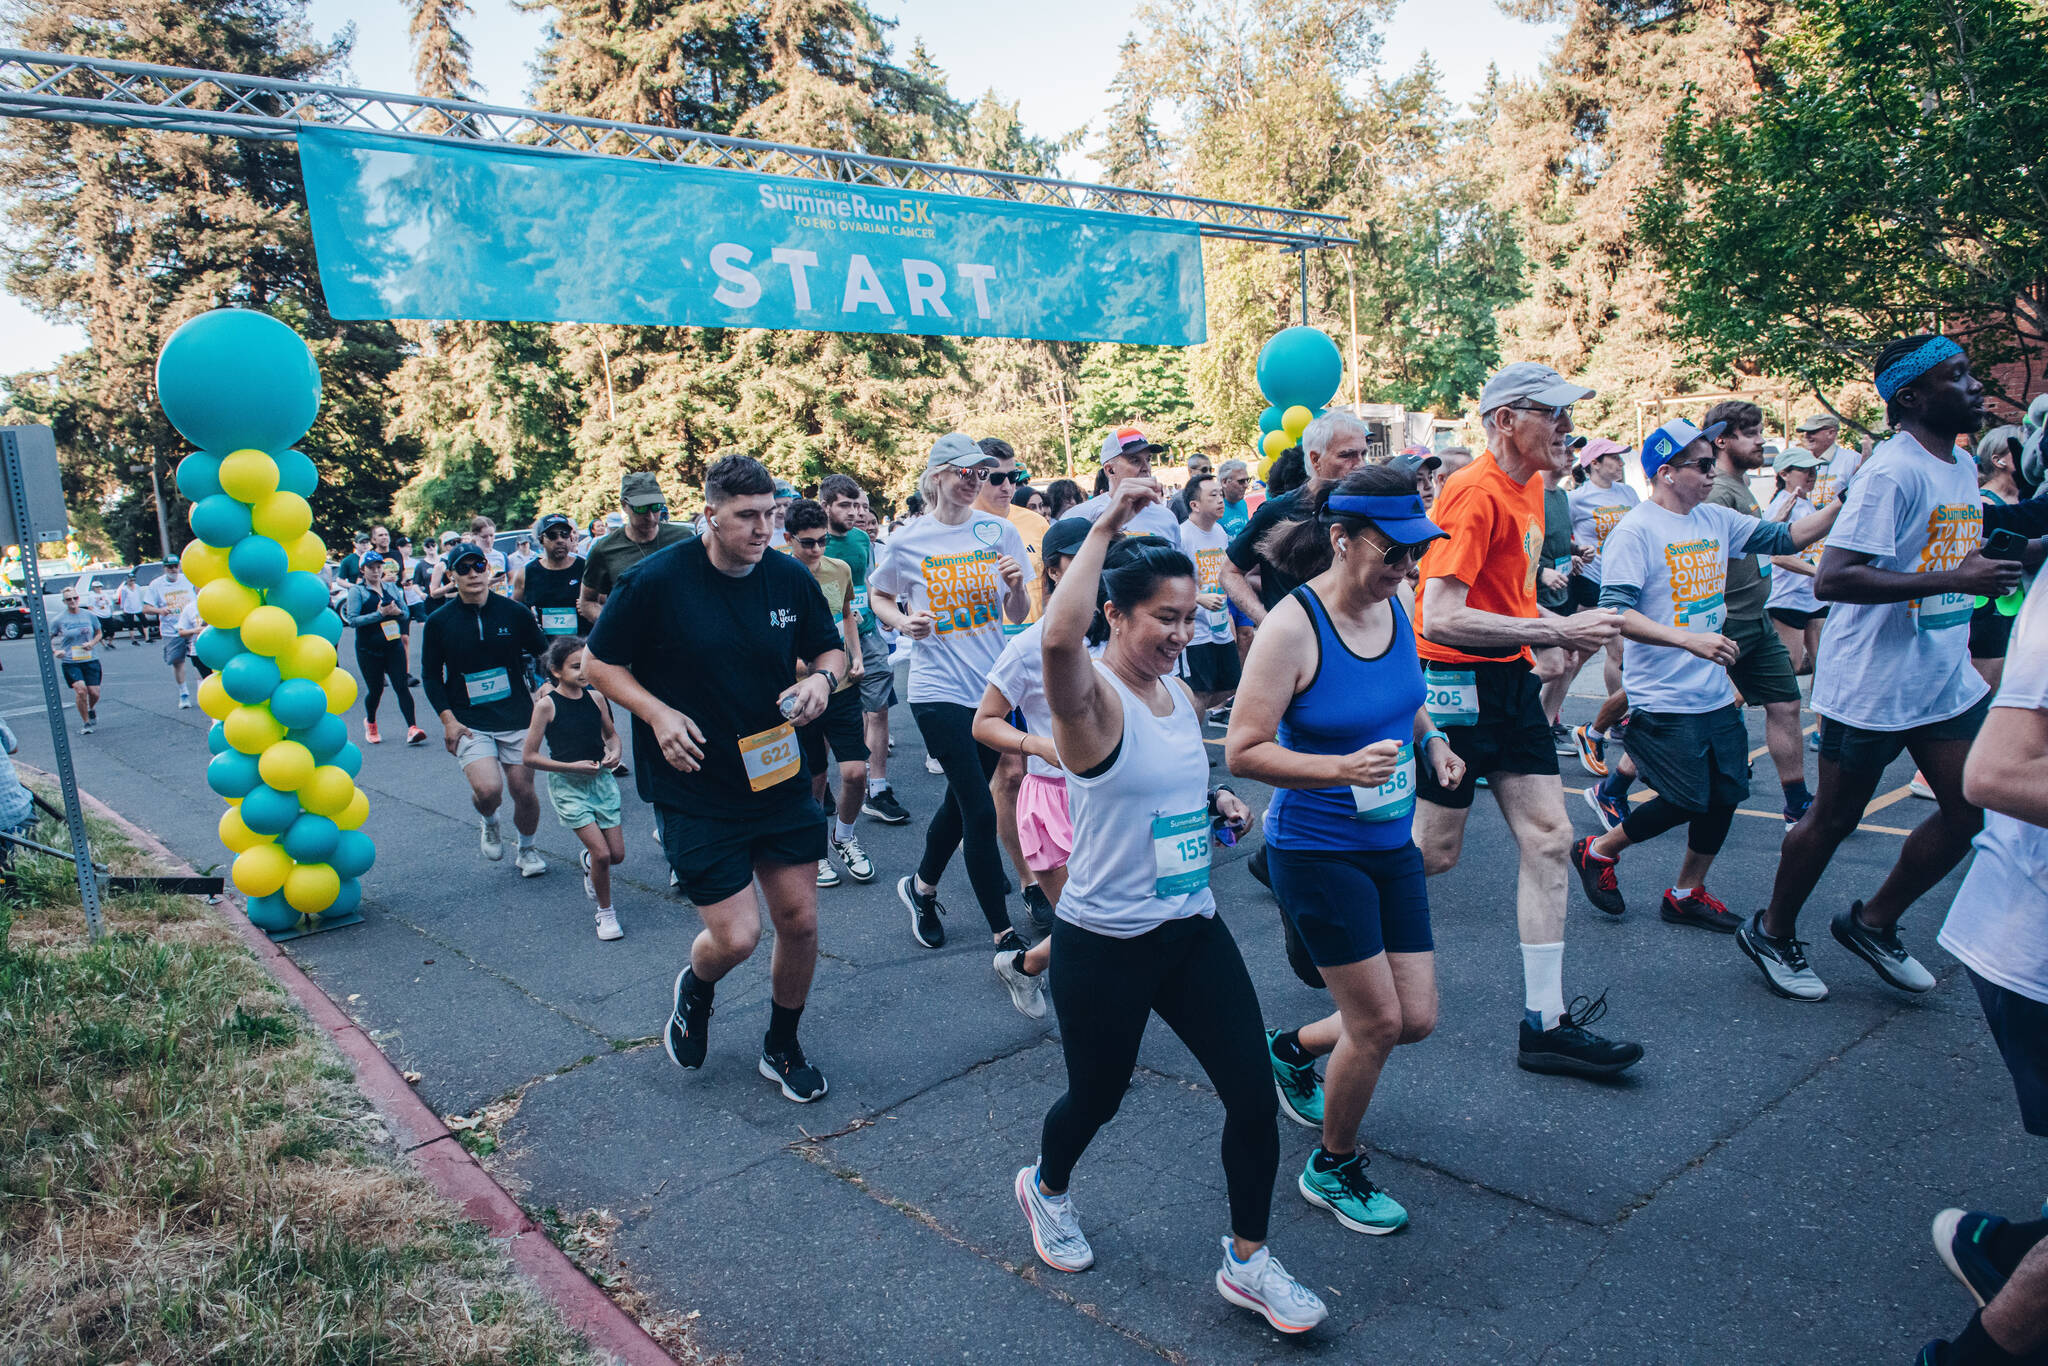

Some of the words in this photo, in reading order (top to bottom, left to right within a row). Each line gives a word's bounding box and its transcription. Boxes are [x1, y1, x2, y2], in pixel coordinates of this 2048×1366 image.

[794, 216, 810, 226] TO
[813, 218, 837, 231] END
[839, 221, 890, 235] OVARIAN
[892, 226, 936, 239] CANCER
[709, 242, 997, 320] START
[925, 549, 998, 568] SummeRun
[1671, 555, 1694, 569] TO
[926, 567, 951, 582] TO
[955, 561, 989, 578] END
[932, 588, 995, 608] CANCER
[1941, 592, 1965, 606] 182
[553, 616, 566, 625] 72
[936, 602, 999, 632] 2024
[1705, 612, 1718, 628] 76
[481, 681, 495, 691] 57
[1426, 690, 1463, 706] 205
[761, 743, 791, 765] 622
[1378, 771, 1408, 797] 158
[1176, 836, 1208, 862] 155
